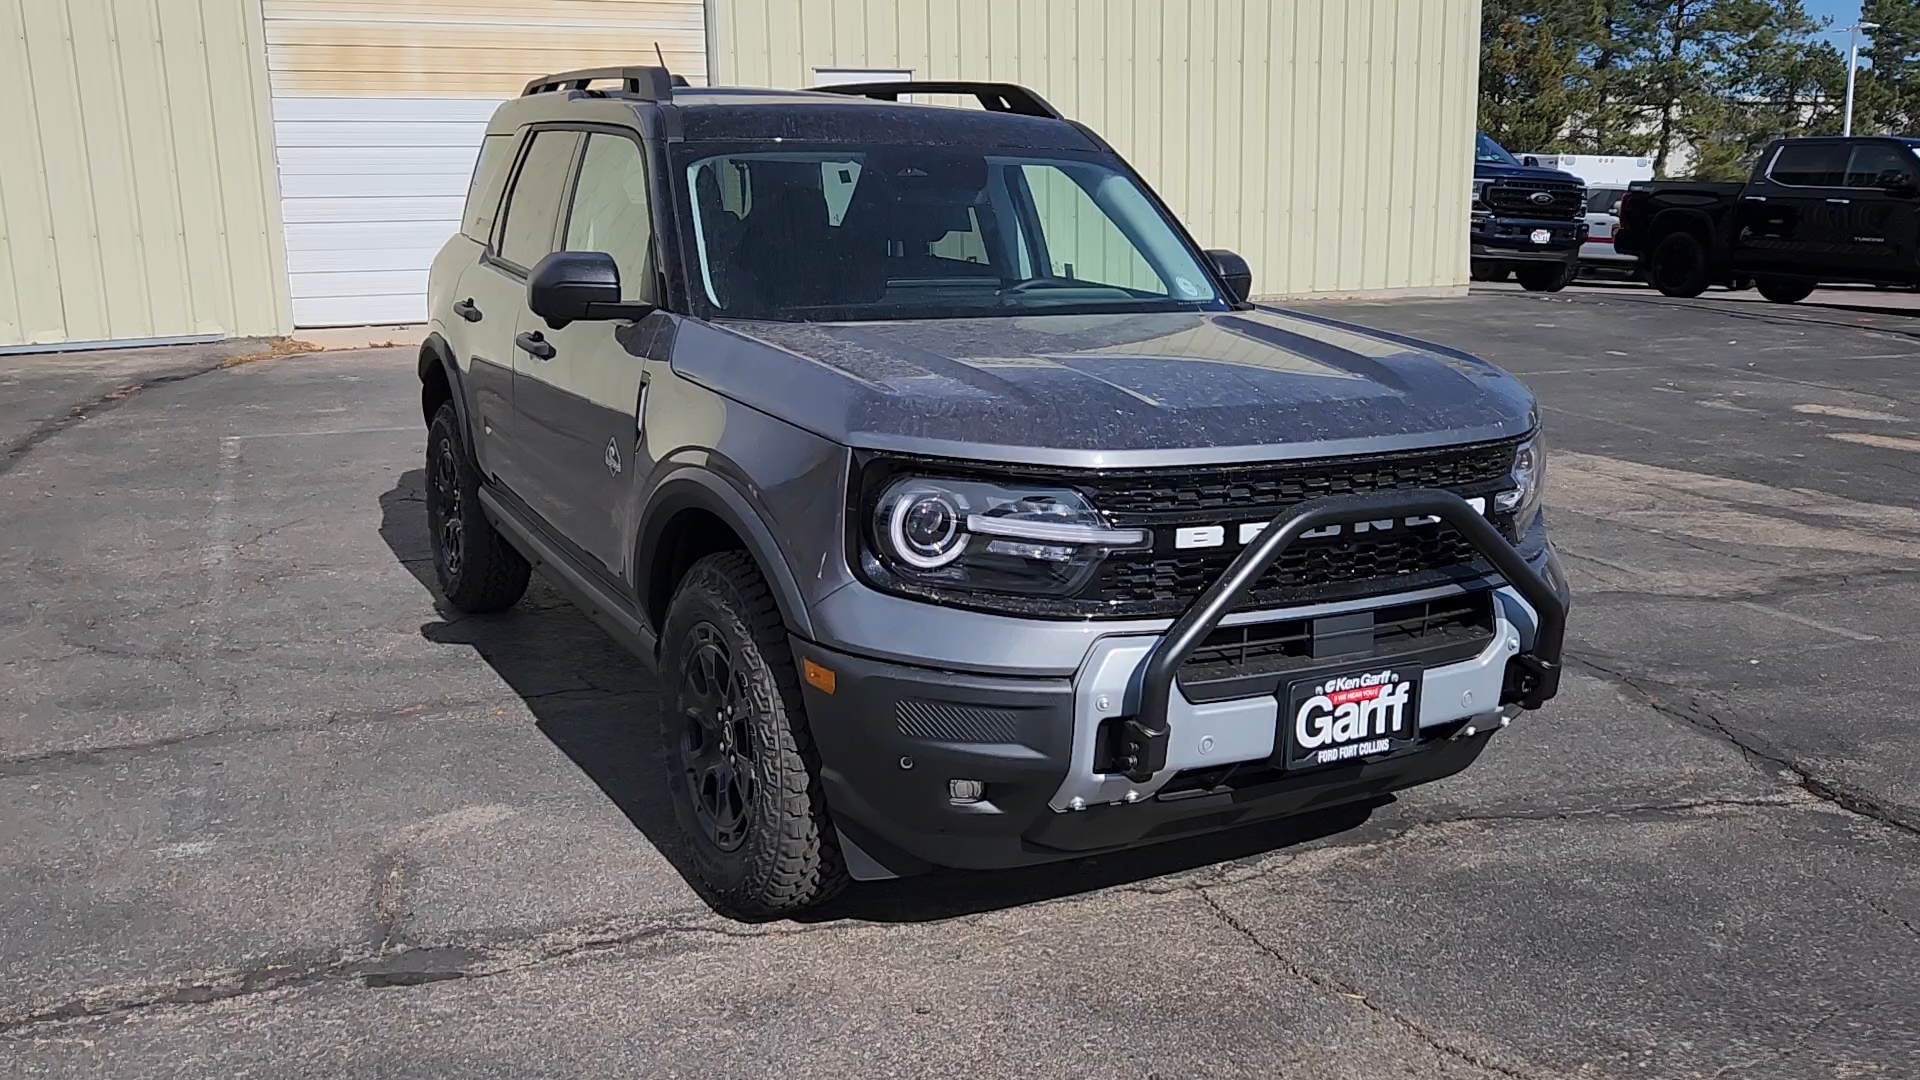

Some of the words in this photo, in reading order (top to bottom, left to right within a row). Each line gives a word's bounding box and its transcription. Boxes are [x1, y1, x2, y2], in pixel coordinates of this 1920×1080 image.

[1335, 677, 1360, 692] Ken
[1360, 670, 1392, 687] Garff
[1296, 681, 1410, 748] Garff
[1317, 748, 1338, 764] FORD
[1339, 744, 1358, 759] FORT
[1359, 738, 1390, 755] COLLINS
